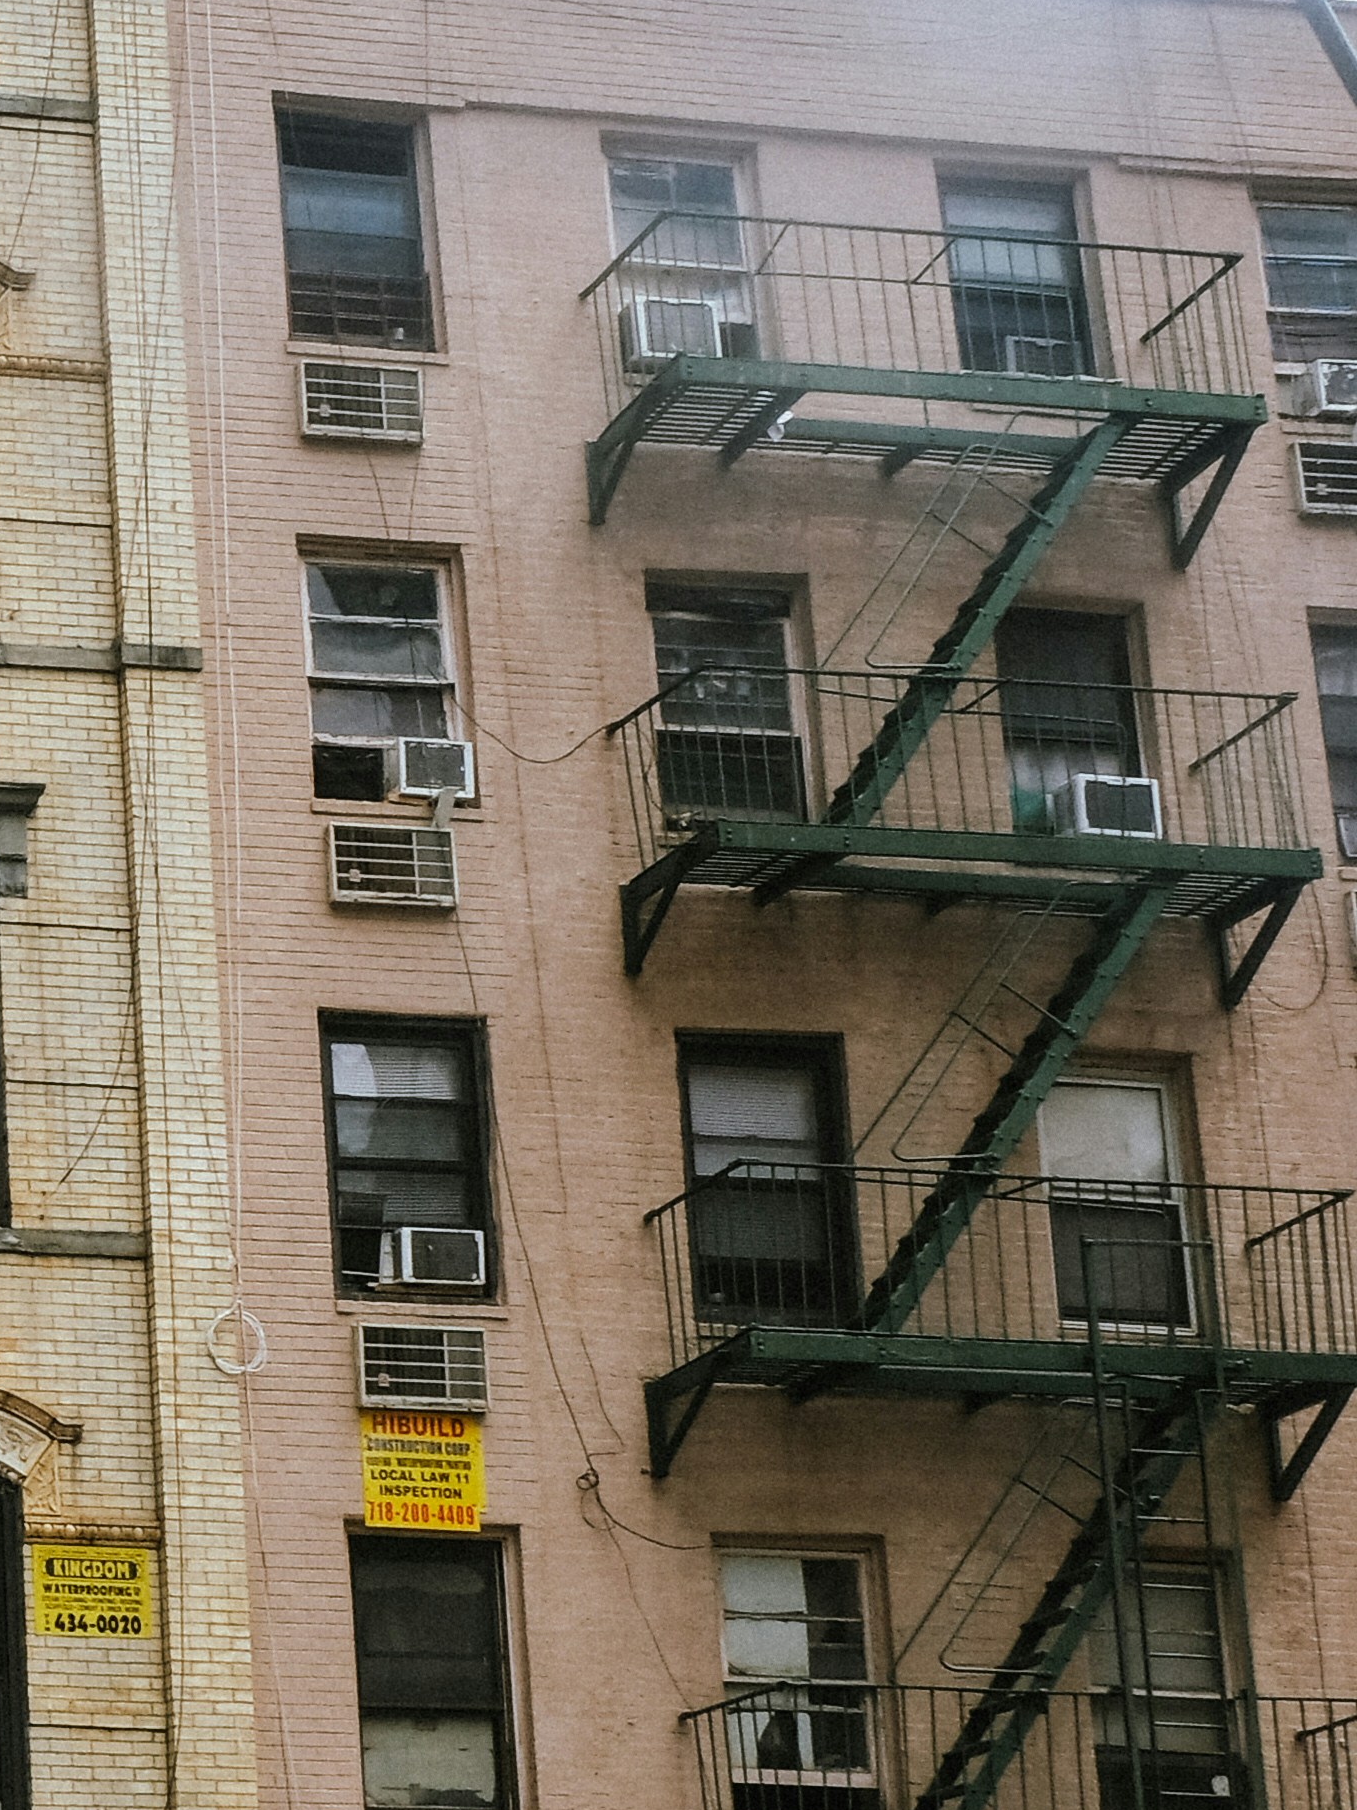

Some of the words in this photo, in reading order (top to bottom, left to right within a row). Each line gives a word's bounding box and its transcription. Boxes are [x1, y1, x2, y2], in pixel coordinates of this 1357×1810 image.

[372, 1412, 465, 1438] HIBUILD
[370, 1469, 416, 1481] LOCAL
[420, 1472, 450, 1483] LAW
[455, 1473, 470, 1484] 11
[379, 1484, 463, 1499] INSPECTION
[367, 1500, 475, 1525] 718-200-4409
[52, 1558, 130, 1579] KINGDOM
[54, 1612, 142, 1635] 434-0020
